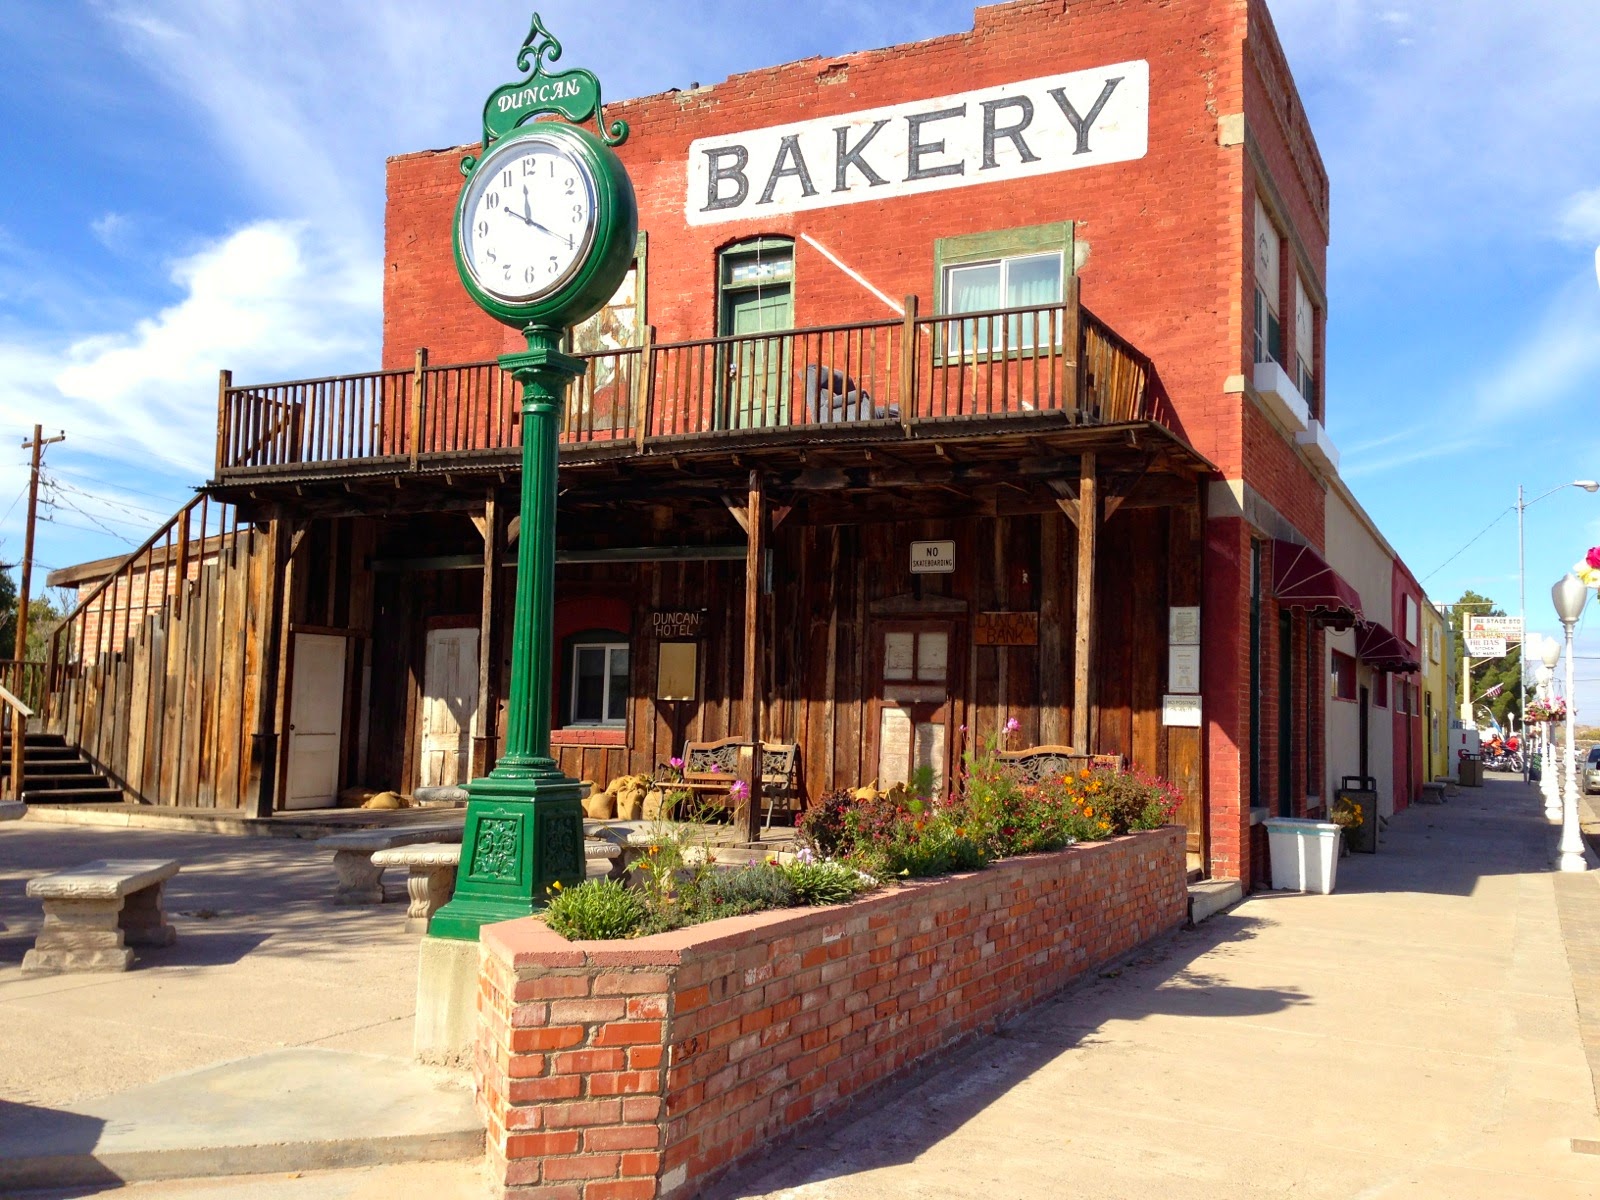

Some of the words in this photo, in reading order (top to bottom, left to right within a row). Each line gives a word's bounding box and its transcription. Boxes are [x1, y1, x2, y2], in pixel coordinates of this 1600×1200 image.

[497, 78, 581, 113] DUNCAN
[700, 76, 1126, 212] BAKERY
[522, 158, 536, 177] 12
[550, 160, 554, 178] 1
[503, 170, 512, 188] 11
[564, 177, 575, 196] 2
[486, 192, 499, 210] 10
[572, 204, 582, 223] 3
[478, 220, 488, 238] 9
[564, 233, 575, 250] 4
[486, 247, 497, 264] 8
[548, 255, 558, 273] 5
[502, 264, 511, 280] 7
[524, 265, 535, 283] 6
[926, 547, 939, 557] NO
[913, 559, 952, 567] SKATEBOARDING
[653, 612, 699, 626] DUNCAN
[978, 613, 1036, 630] DUNCAN
[655, 624, 693, 636] HOTEL
[986, 629, 1025, 643] BANK
